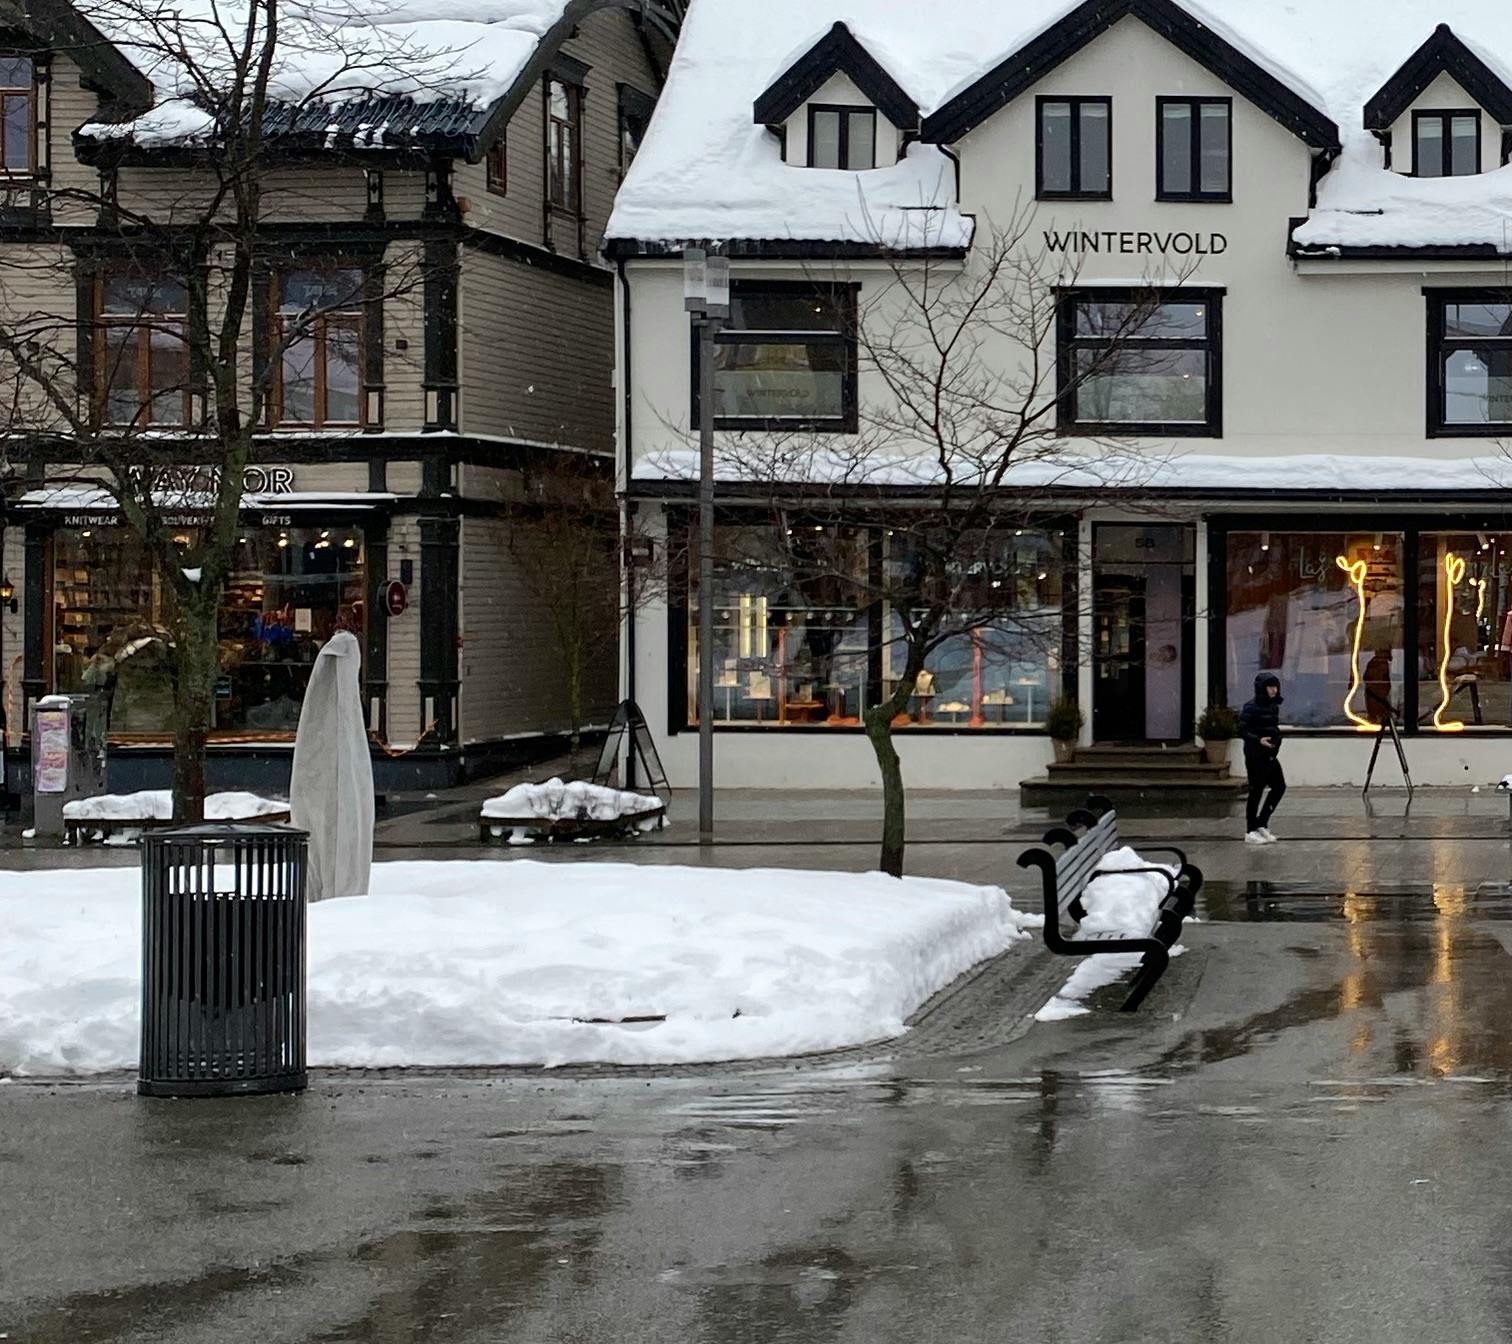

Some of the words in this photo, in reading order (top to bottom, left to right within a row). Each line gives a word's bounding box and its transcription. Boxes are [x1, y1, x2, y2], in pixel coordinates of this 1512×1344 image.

[1043, 231, 1227, 254] WINTERVOLD
[64, 516, 118, 526] KNITWEAR
[262, 515, 292, 526] GIFTS
